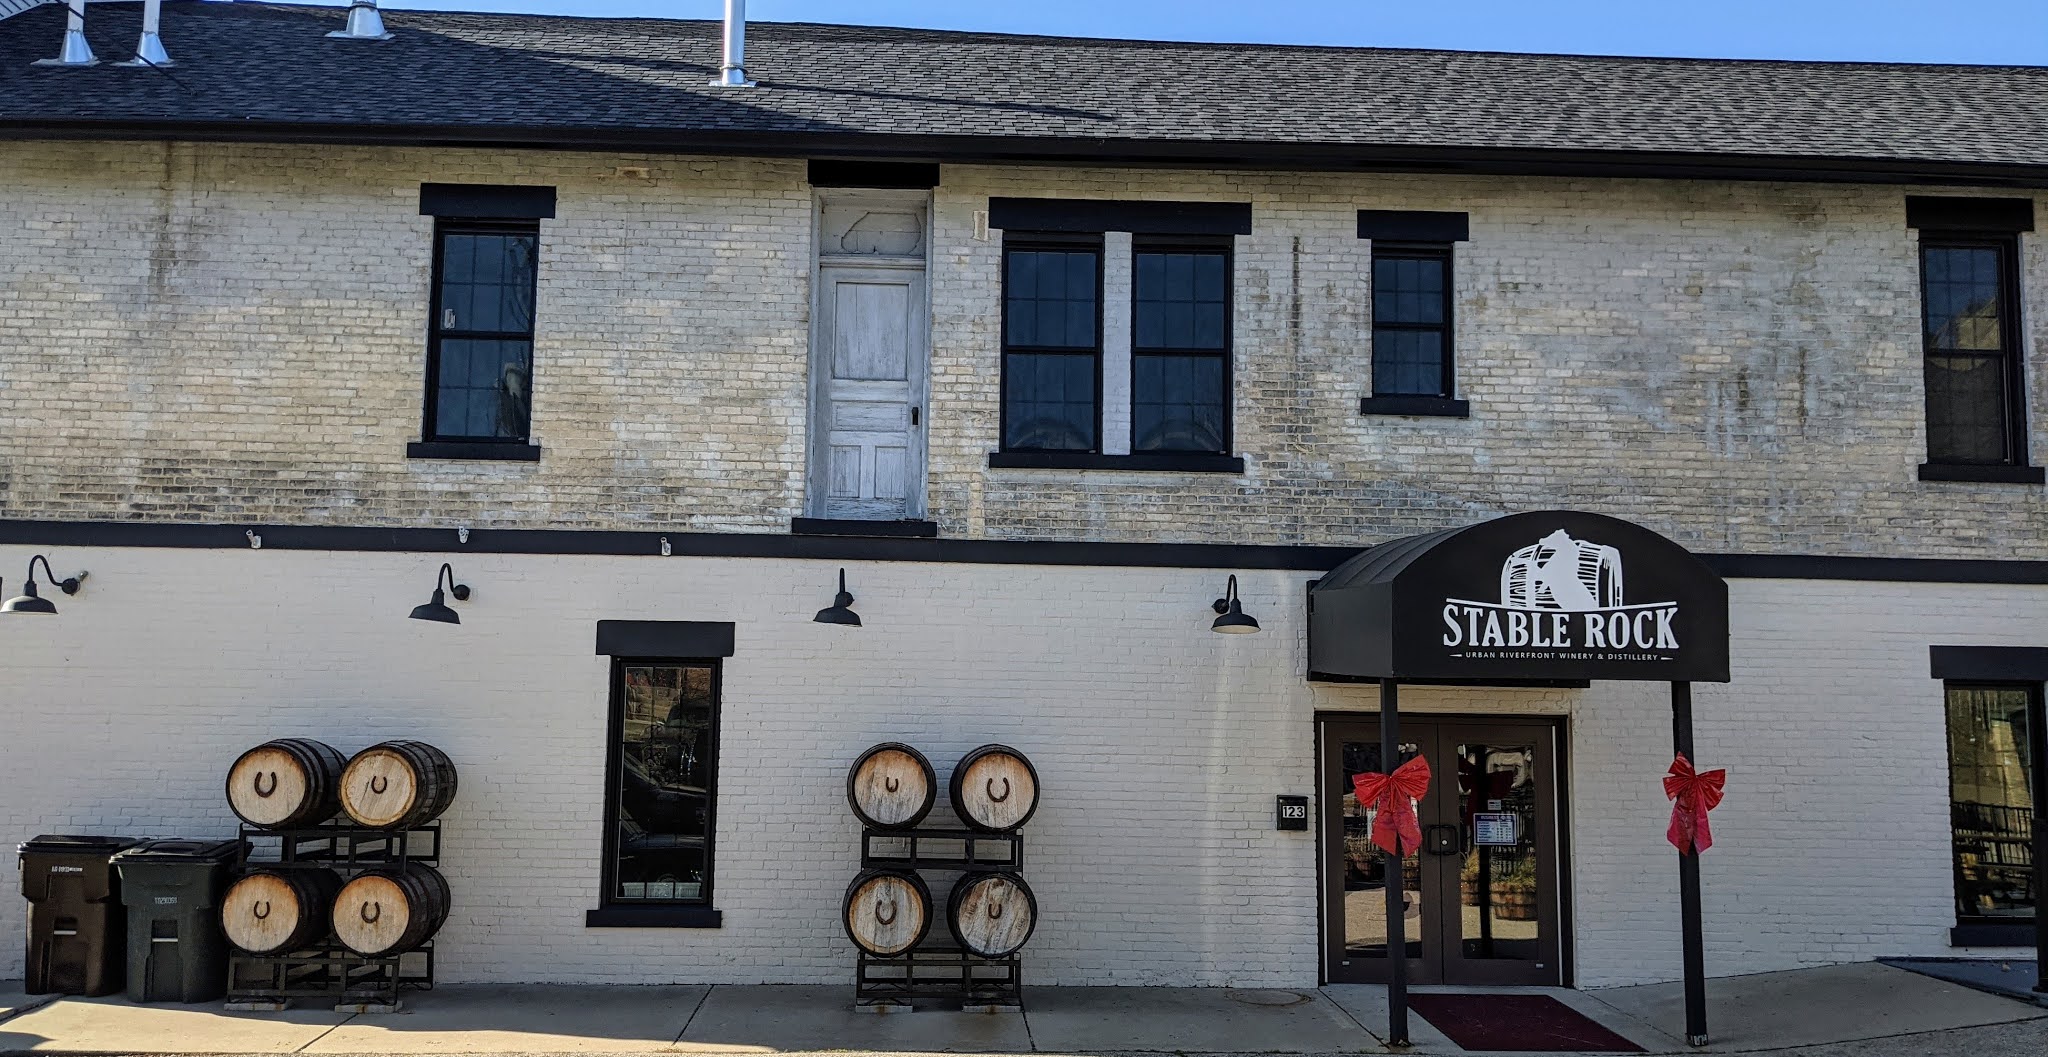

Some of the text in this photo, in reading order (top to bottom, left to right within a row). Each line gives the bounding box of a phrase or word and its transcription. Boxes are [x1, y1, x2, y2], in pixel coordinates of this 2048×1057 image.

[1443, 604, 1679, 649] STABLE ROCK
[1465, 651, 1496, 659] URBAN
[1499, 651, 1556, 659] RIVERFRONT
[1559, 652, 1594, 660] WINERY
[1607, 653, 1659, 661] DISTILLERY
[1283, 806, 1304, 818] 123
